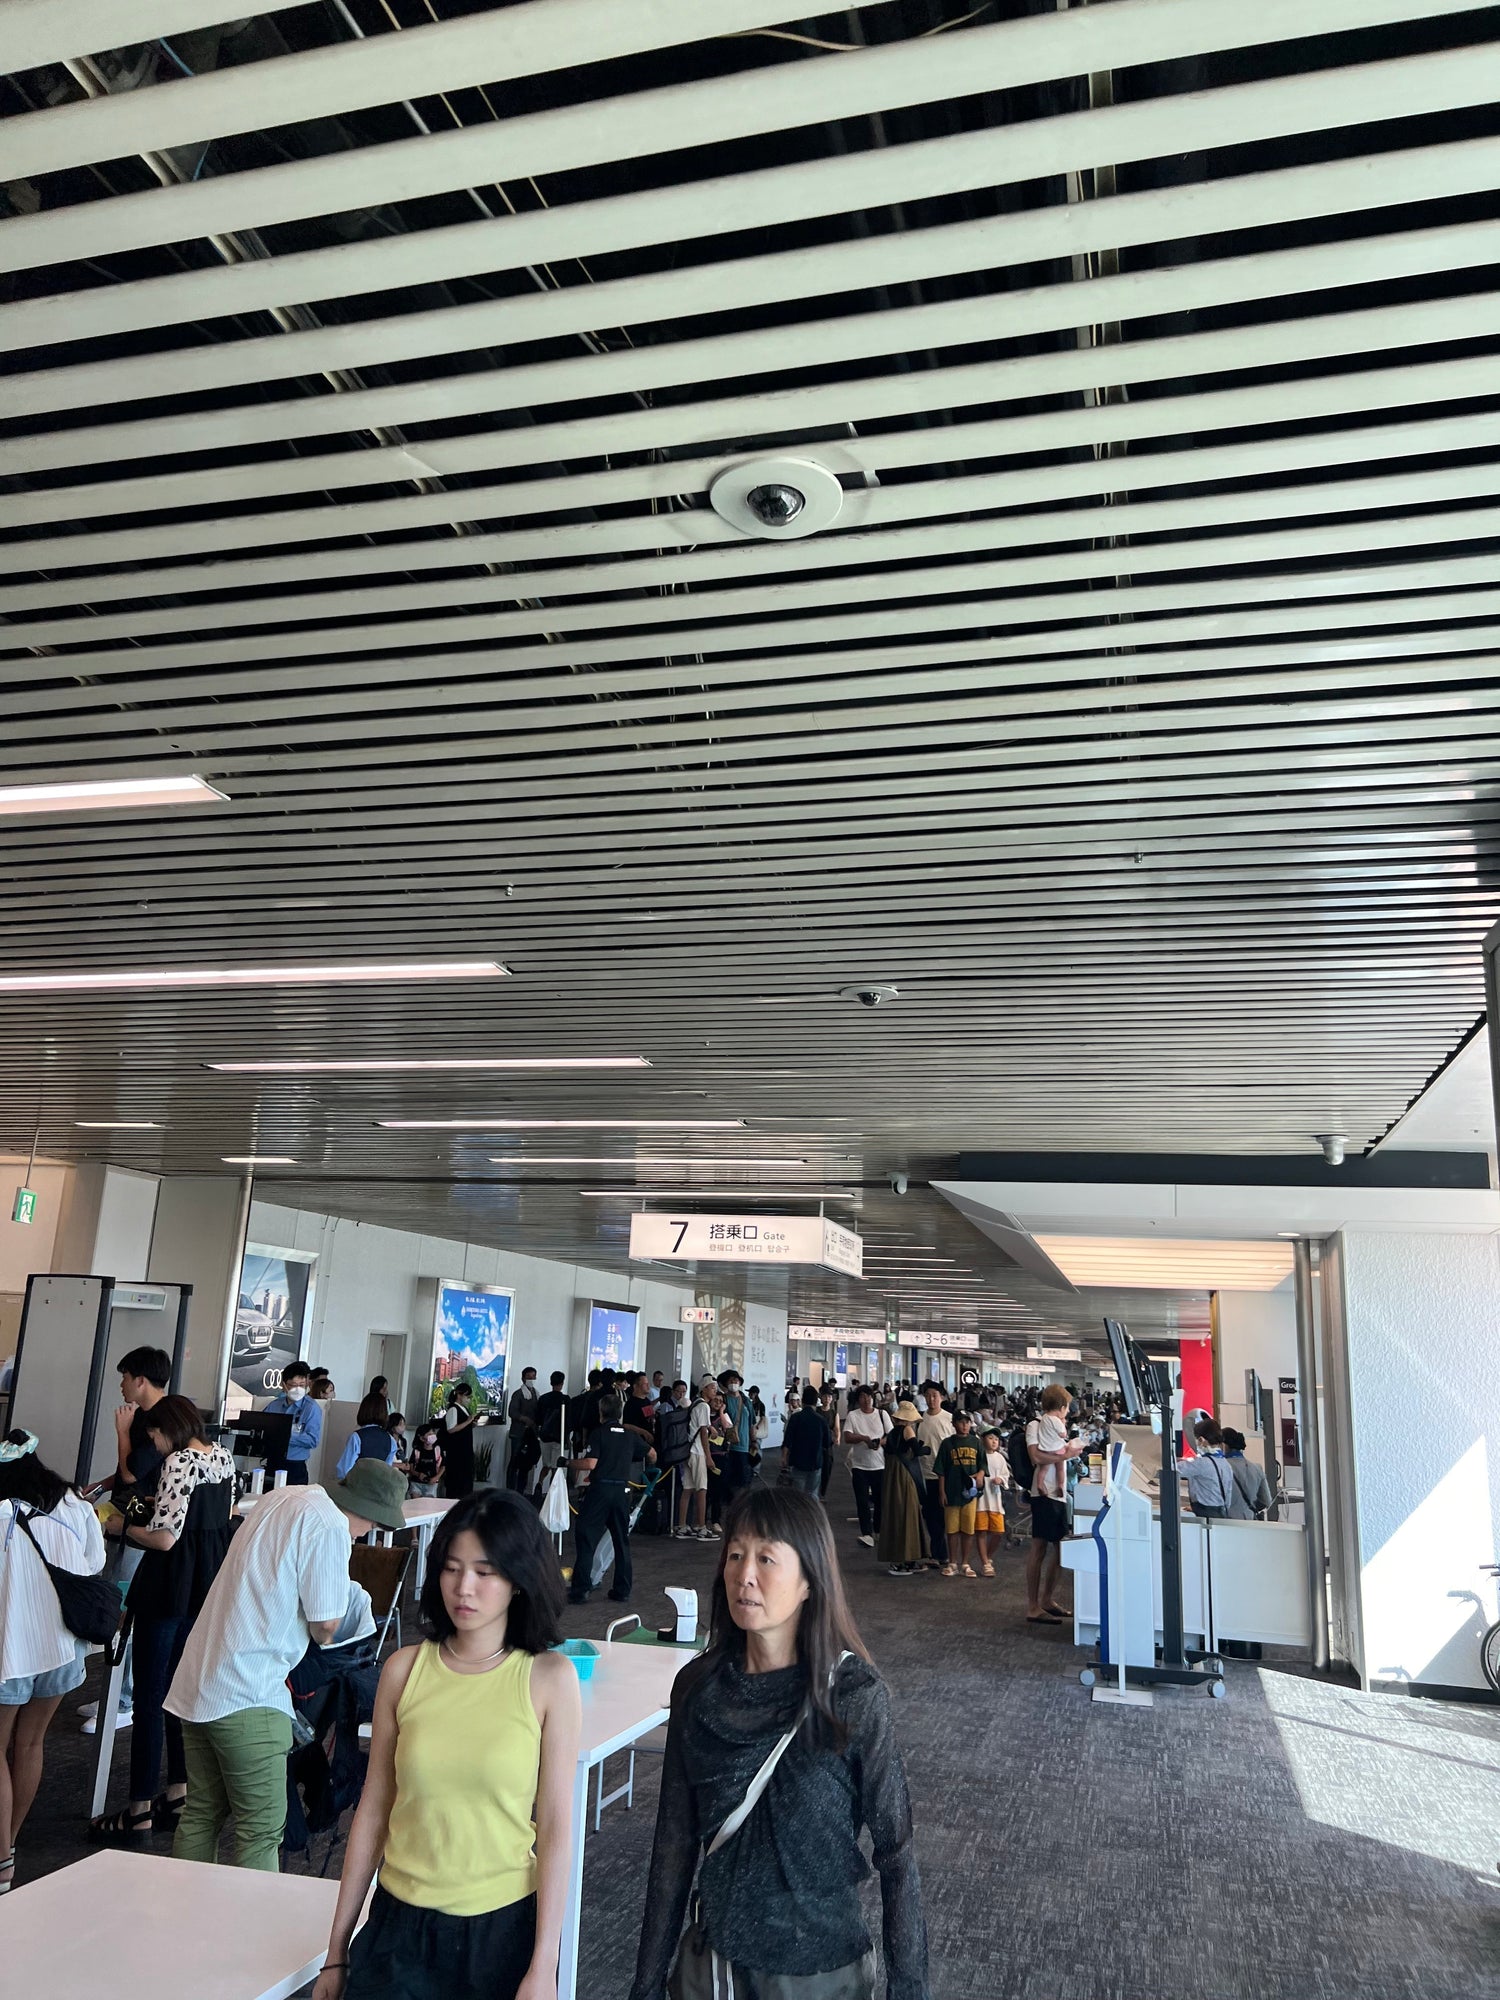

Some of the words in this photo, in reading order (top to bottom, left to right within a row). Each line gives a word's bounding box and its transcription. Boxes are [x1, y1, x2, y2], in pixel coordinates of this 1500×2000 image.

[670, 1221, 689, 1253] 7
[709, 1224, 758, 1240] 搭乗口
[763, 1231, 786, 1241] Gate
